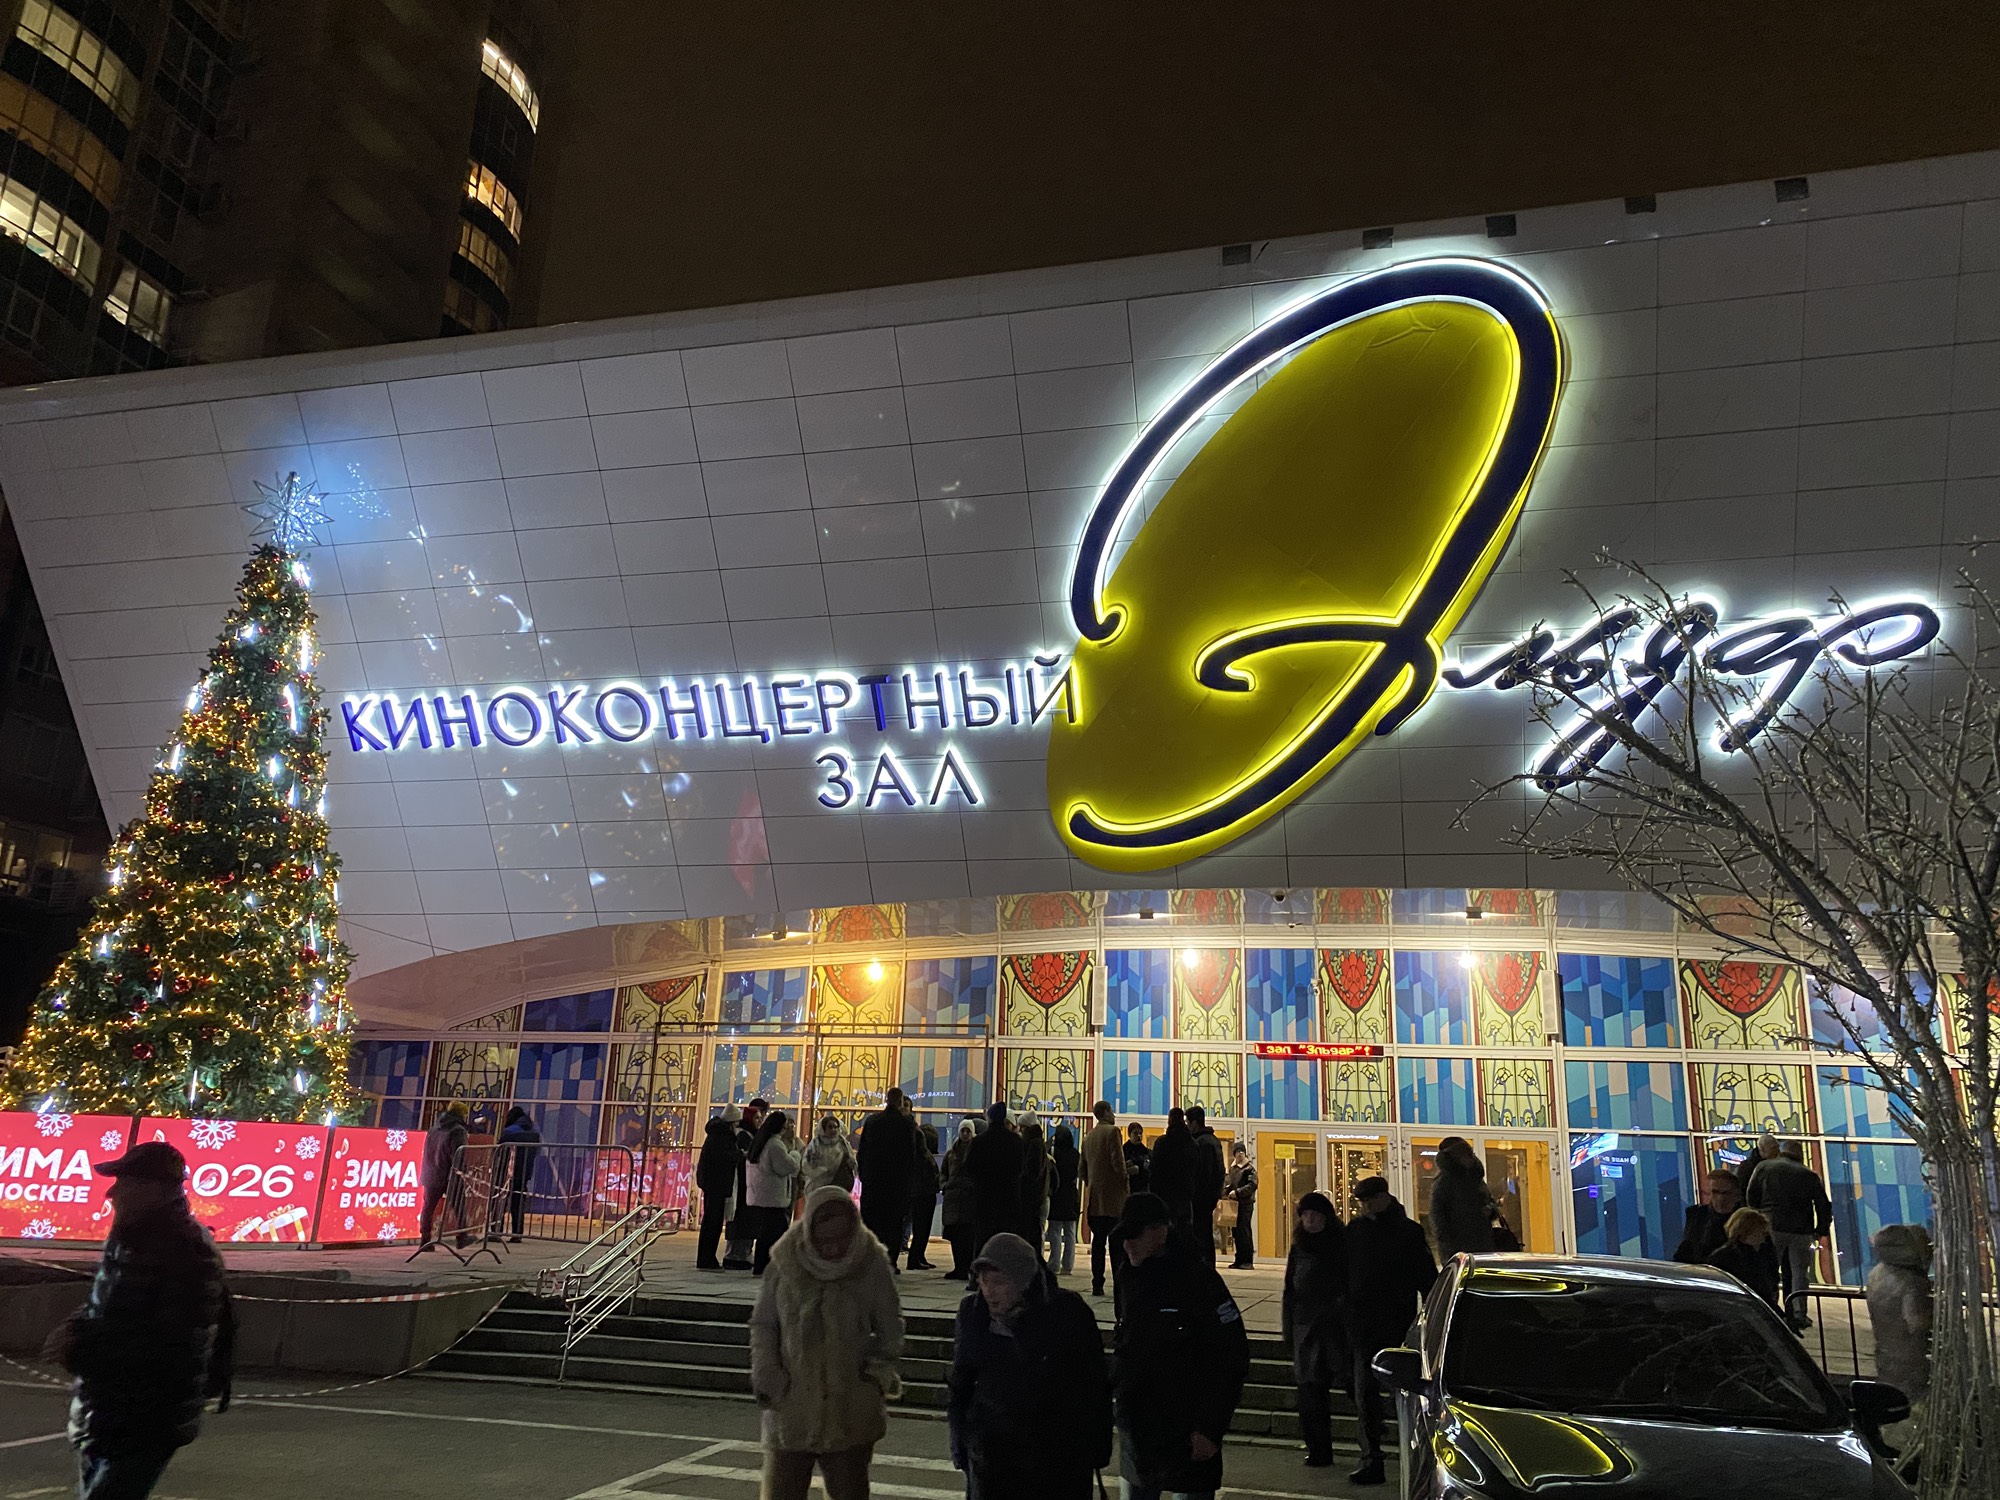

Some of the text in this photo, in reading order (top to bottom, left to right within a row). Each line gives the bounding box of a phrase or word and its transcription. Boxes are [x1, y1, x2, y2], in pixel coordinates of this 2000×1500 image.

[341, 653, 1077, 752] КИНОКОНЦЕРТНЫЙ
[817, 748, 983, 809] ЗАЛ
[0, 1146, 93, 1181] ИМА
[183, 1163, 295, 1198] 026
[343, 1159, 419, 1189] ЗИМА
[0, 1183, 91, 1204] ОСКВЕ
[339, 1191, 417, 1209] В МОСКВЕ
